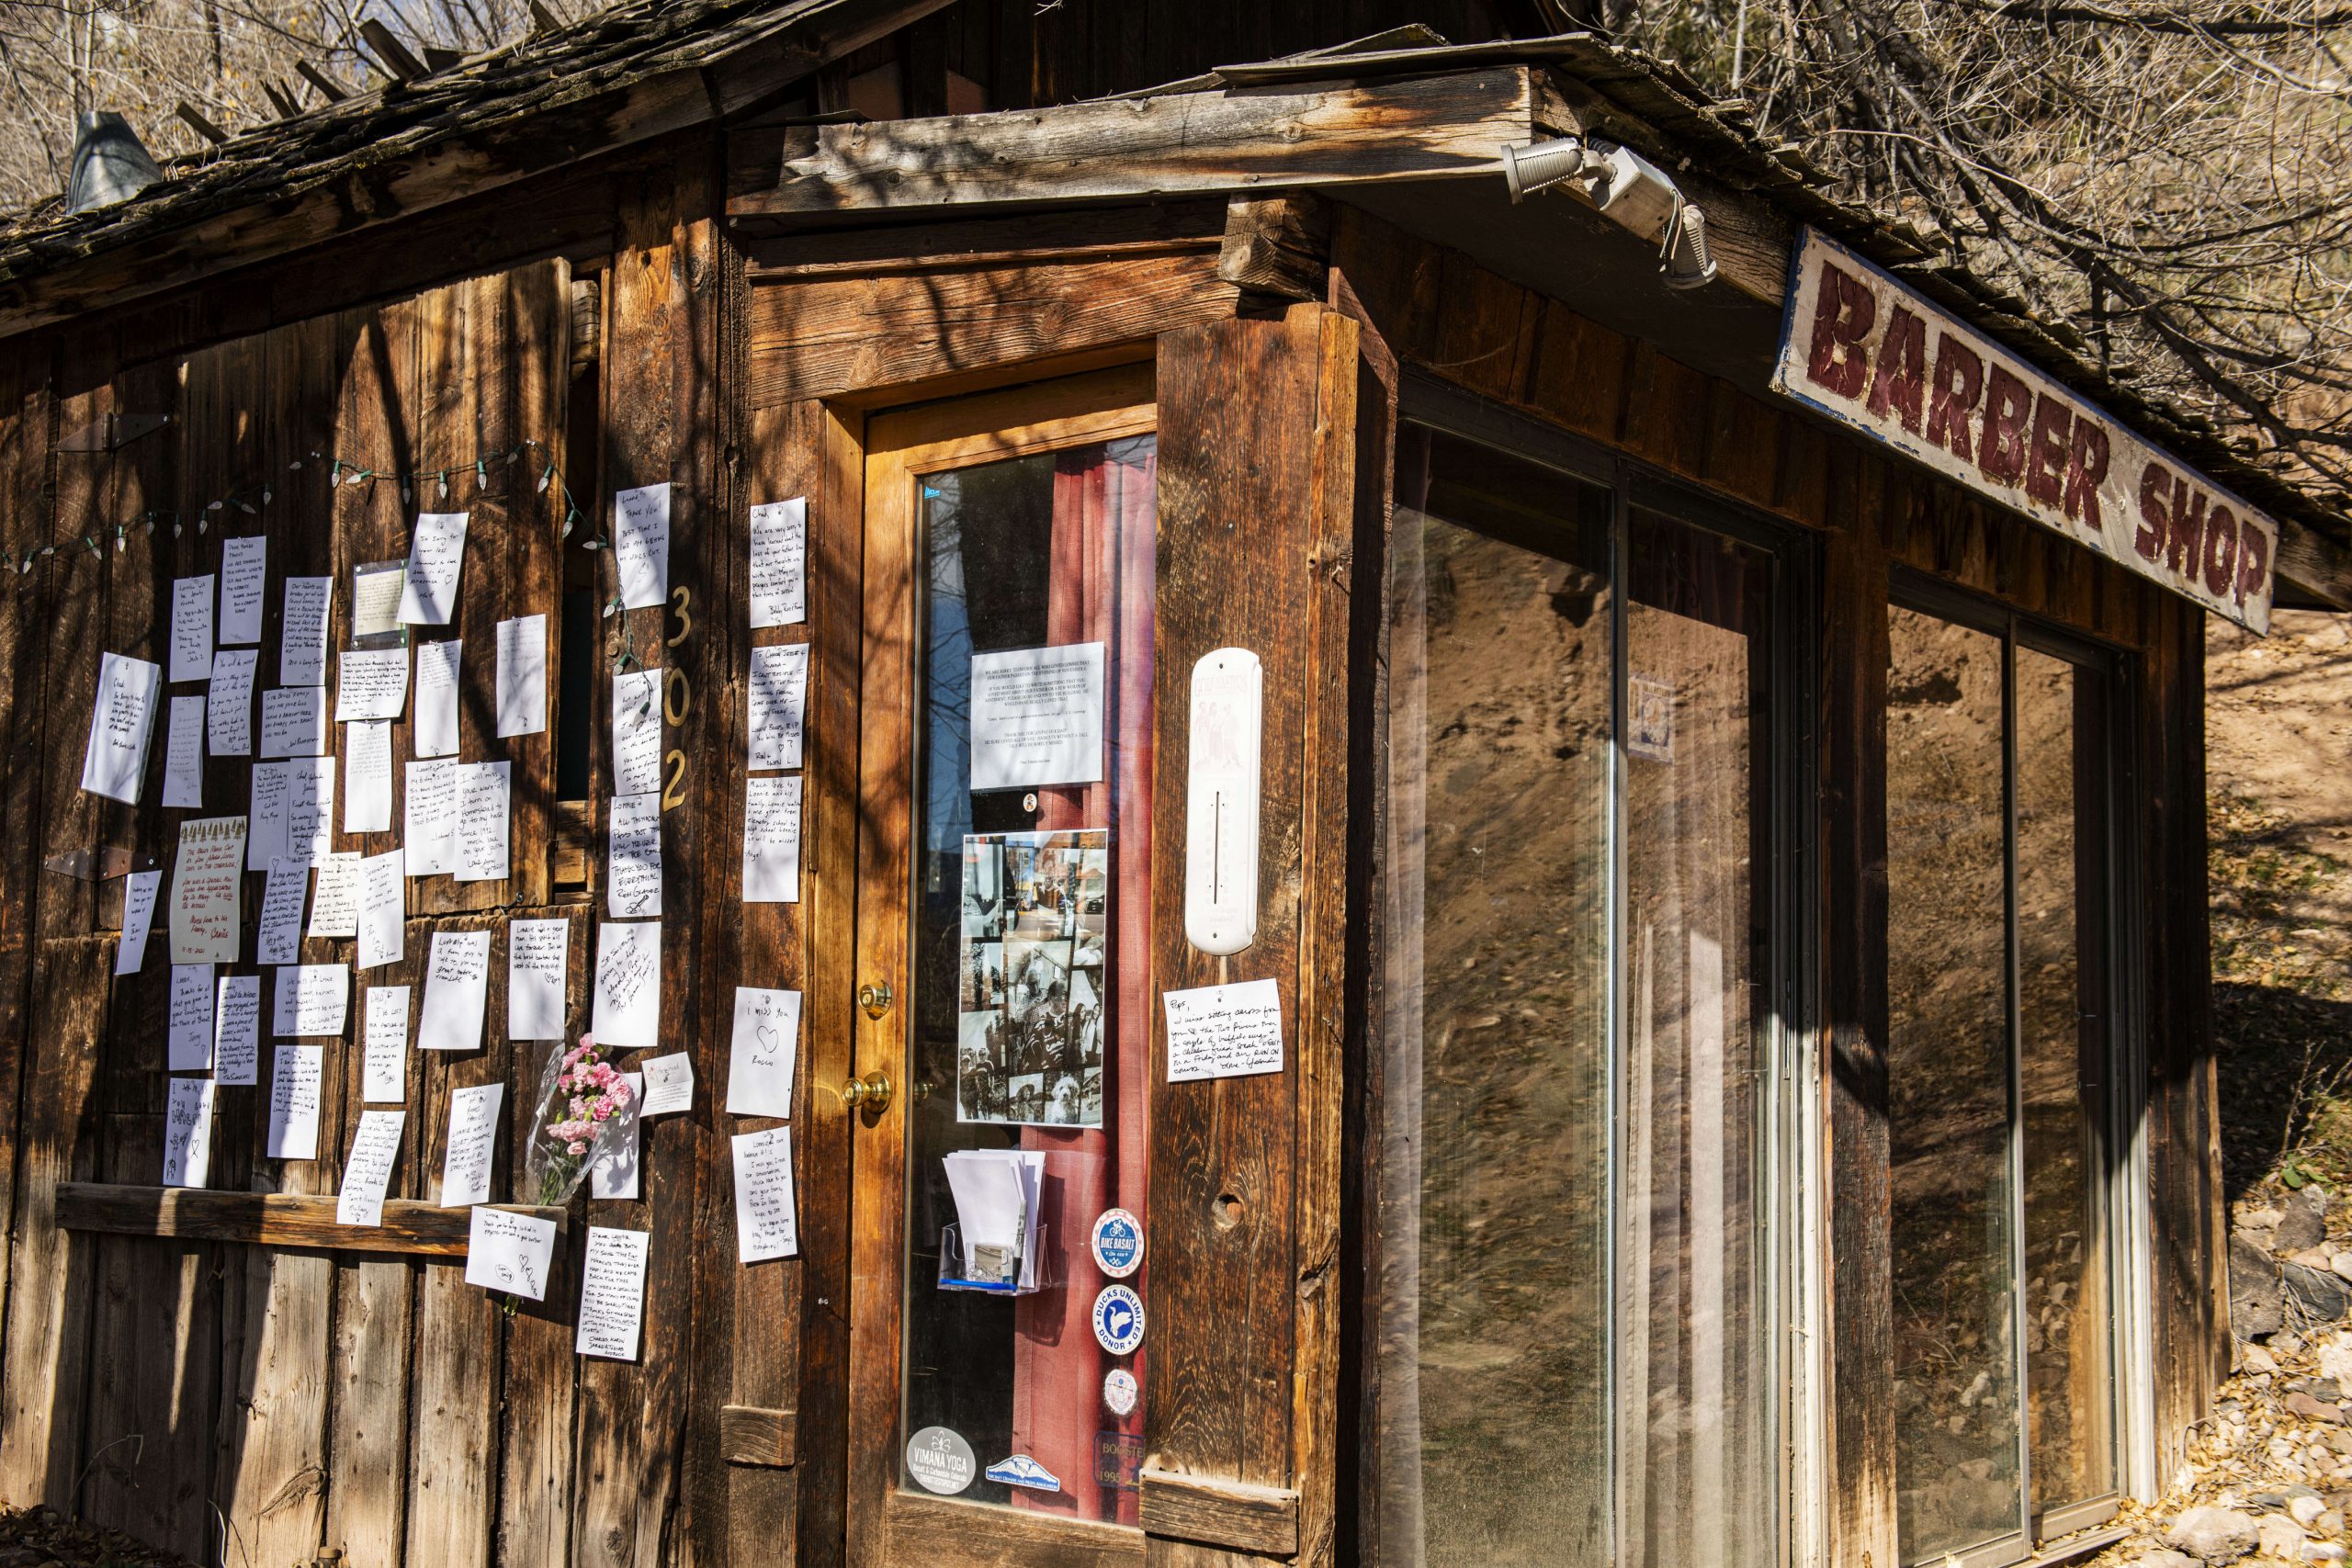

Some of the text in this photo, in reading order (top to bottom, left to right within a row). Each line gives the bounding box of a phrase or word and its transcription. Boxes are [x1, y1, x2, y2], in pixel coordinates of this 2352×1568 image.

[1807, 259, 2267, 609] BARBER SHOP
[1101, 1237, 1135, 1250] BIKE BASALT
[1097, 1290, 1142, 1339] DUCKS UNLIMITED
[1099, 1329, 1125, 1349] DONOR
[915, 1448, 967, 1473] VIMANA YOGA
[1101, 1471, 1121, 1483] 1995
